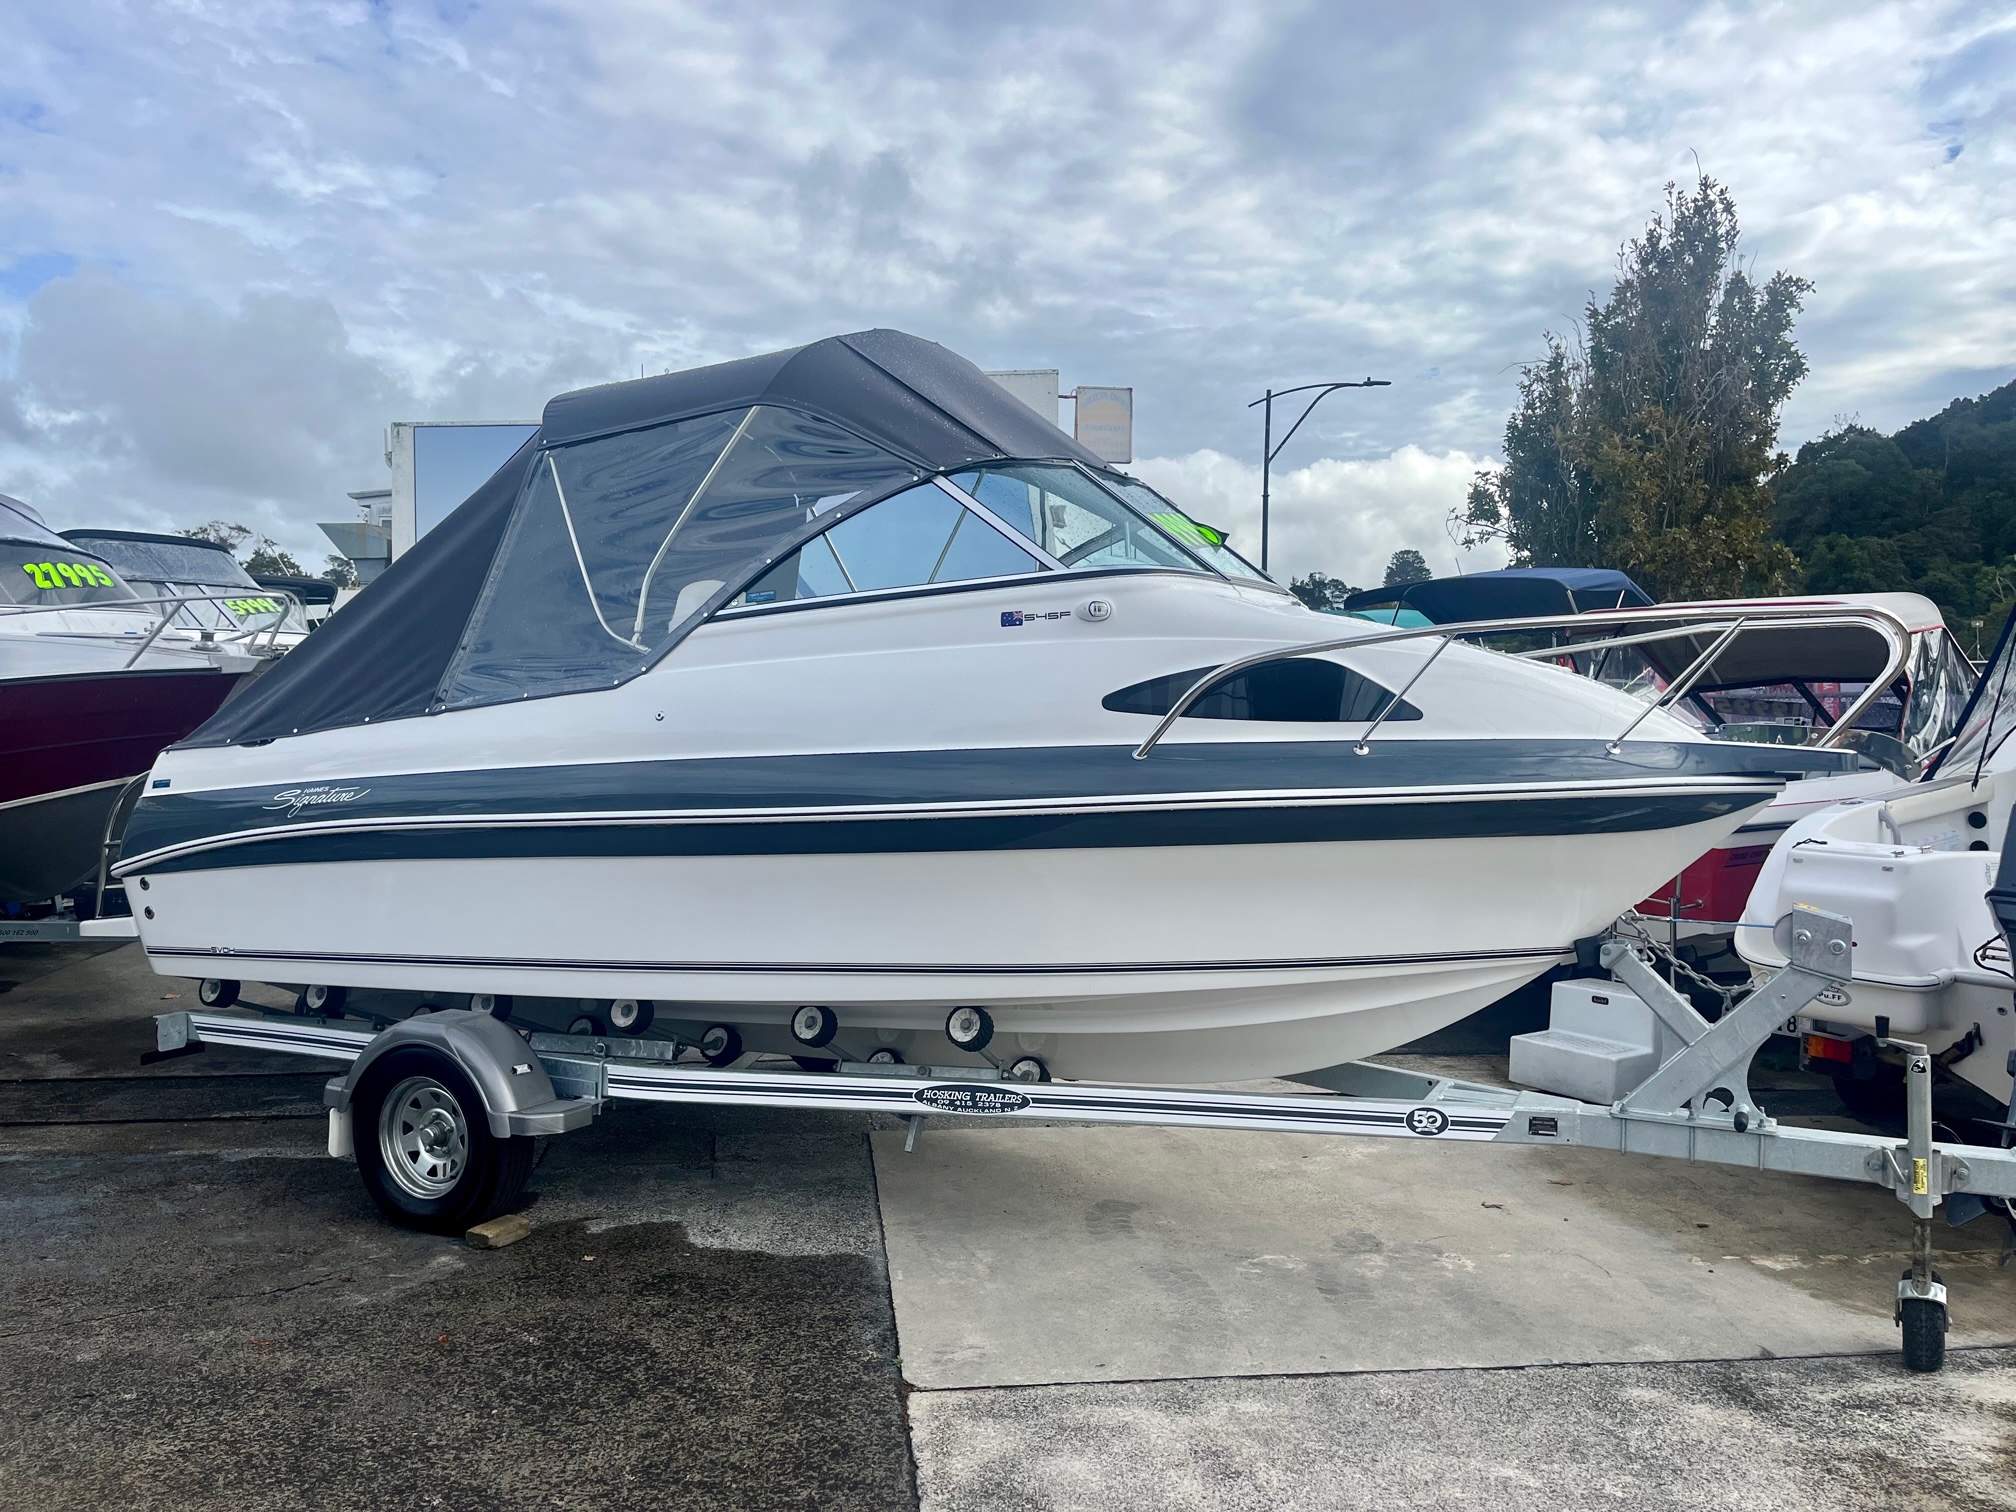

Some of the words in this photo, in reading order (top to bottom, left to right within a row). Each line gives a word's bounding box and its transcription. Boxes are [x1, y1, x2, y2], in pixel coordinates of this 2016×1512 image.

[23, 562, 115, 589] 27995
[224, 598, 283, 616] 59995
[1024, 611, 1071, 621] 545F
[303, 786, 330, 794] HAINES
[262, 786, 371, 818] Signature
[922, 1089, 971, 1101] HOSKING
[975, 1092, 1023, 1104] TRAILERS
[922, 1099, 954, 1111] ALBANY
[956, 1106, 1002, 1114] AUCKLAND
[1412, 1110, 1443, 1129] 50
